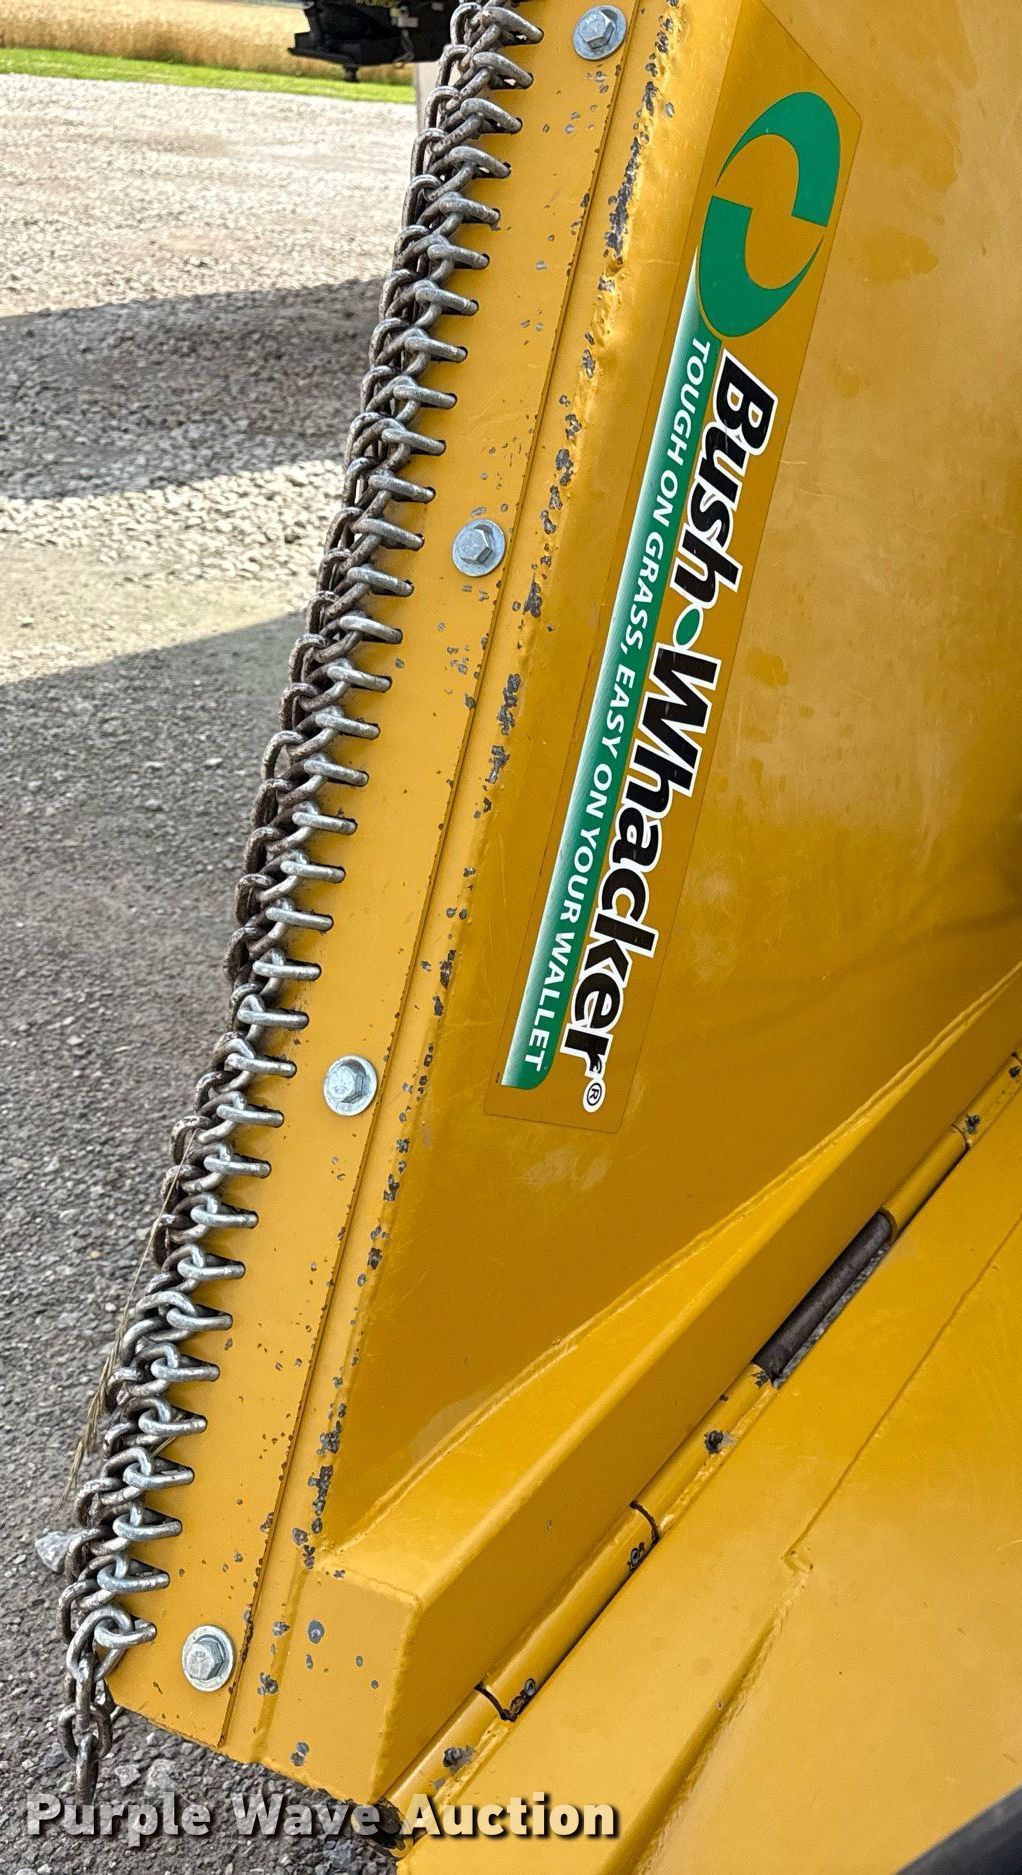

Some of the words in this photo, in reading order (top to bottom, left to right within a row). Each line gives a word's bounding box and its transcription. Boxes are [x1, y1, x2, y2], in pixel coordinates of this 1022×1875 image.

[666, 337, 711, 464] TOUGH
[652, 471, 680, 528] ON
[621, 531, 664, 656] GRASS,
[602, 664, 636, 757] EASY
[585, 764, 614, 820] ON
[559, 827, 600, 924] YOUR
[524, 931, 578, 1073] WALLET
